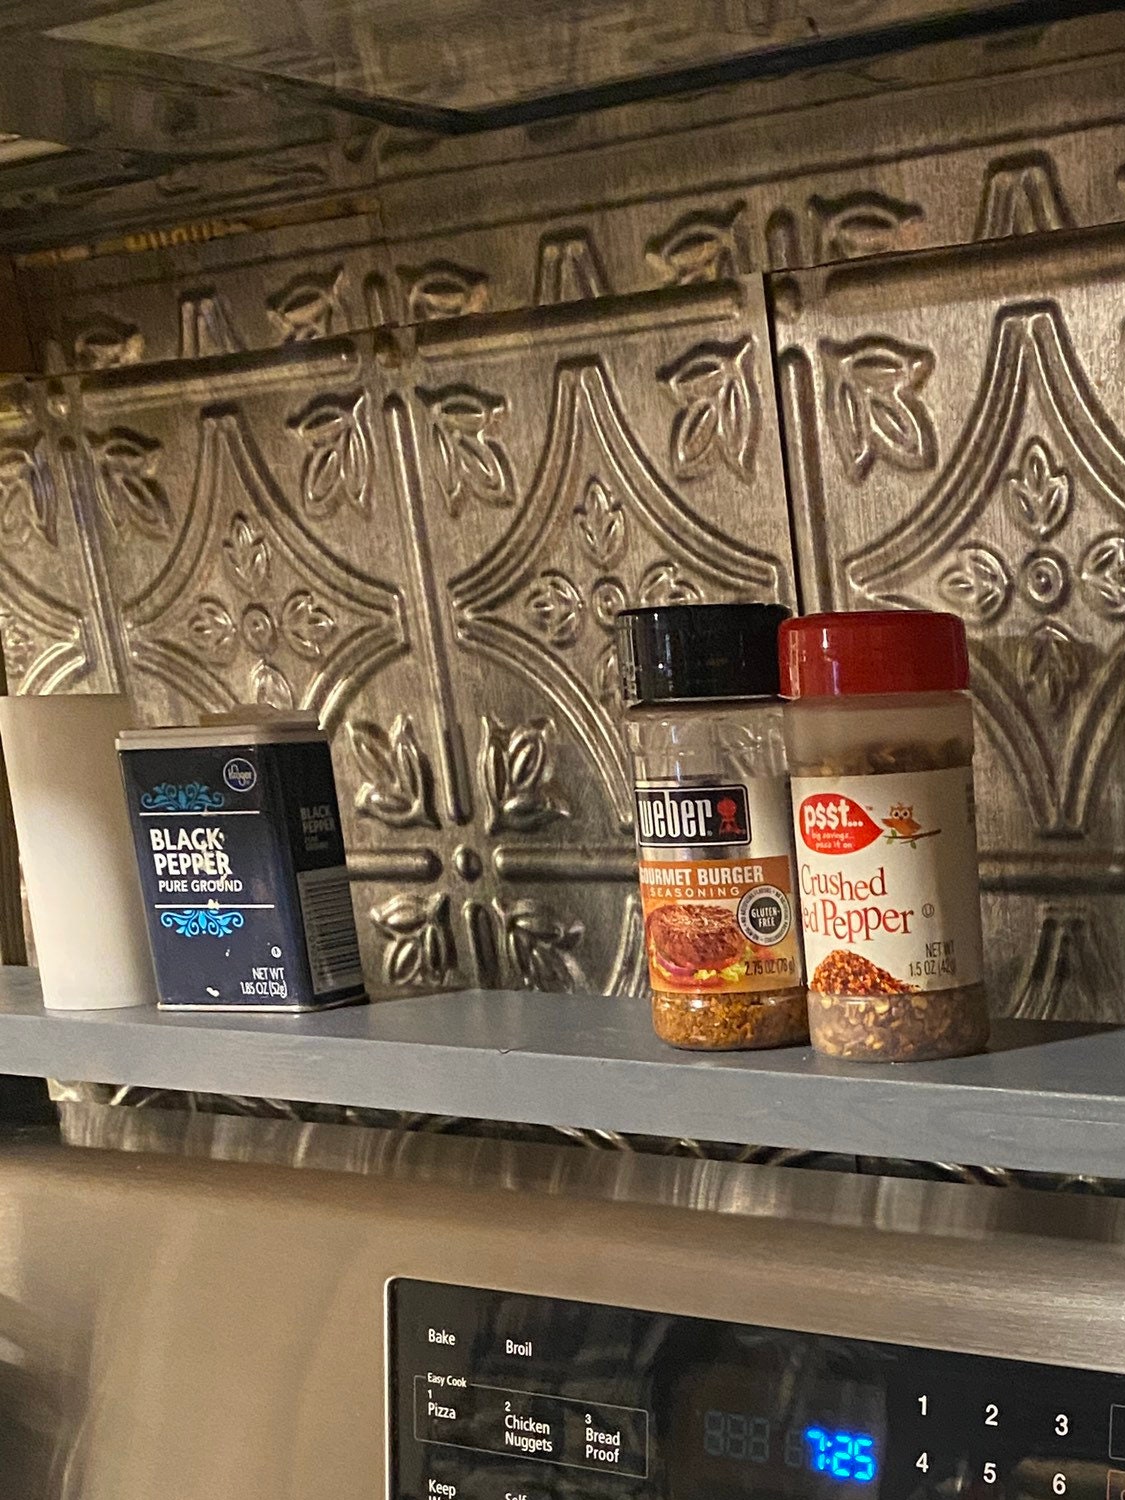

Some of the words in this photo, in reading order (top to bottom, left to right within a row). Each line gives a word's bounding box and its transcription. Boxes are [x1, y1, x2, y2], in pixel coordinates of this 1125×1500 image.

[638, 788, 713, 838] weber
[150, 828, 223, 850] BLACK
[154, 852, 232, 876] PEPPER
[697, 864, 764, 886] BURGER
[801, 863, 888, 901] Crushed
[159, 880, 188, 892] PURE
[191, 880, 243, 893] GROUND
[650, 886, 740, 898] SEASONING
[758, 916, 776, 928] FREE
[803, 902, 819, 933] ed
[820, 899, 914, 943] Pepper
[925, 941, 941, 958] NET
[252, 967, 268, 980] NET
[269, 967, 284, 980] WT
[745, 960, 763, 976] 2.75
[909, 961, 922, 977] 1.5
[924, 959, 937, 976] OZ
[256, 981, 269, 995] OZ
[428, 1328, 456, 1347] Bake
[505, 1339, 533, 1357] Broil
[427, 1372, 445, 1387] Easy
[446, 1375, 467, 1388] Cook
[427, 1389, 432, 1399] 1
[428, 1401, 456, 1420] Pizza
[504, 1401, 511, 1412] 2
[918, 1394, 928, 1416] 1
[504, 1415, 550, 1435] Chicken
[585, 1413, 592, 1425] 3
[985, 1404, 999, 1427] 2
[1054, 1413, 1069, 1437] 3
[504, 1431, 553, 1453] Nuggets
[585, 1427, 621, 1446] Bread
[585, 1444, 620, 1463] Proof
[806, 1428, 875, 1481] 7:25
[915, 1451, 930, 1473] 4
[983, 1462, 997, 1484] 5
[428, 1479, 457, 1498] Keep
[1051, 1473, 1067, 1495] 6
